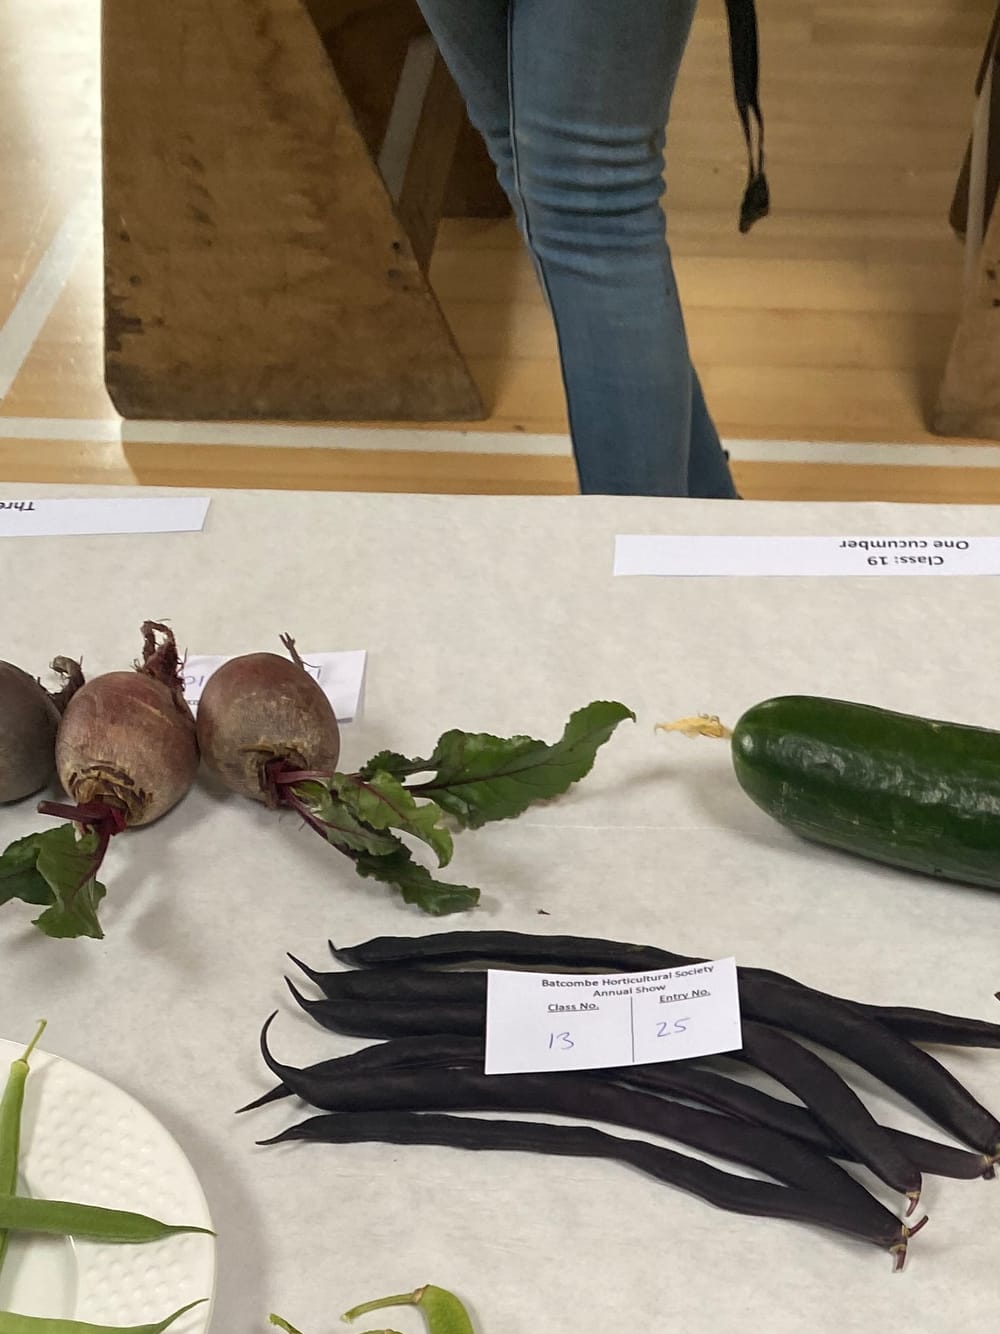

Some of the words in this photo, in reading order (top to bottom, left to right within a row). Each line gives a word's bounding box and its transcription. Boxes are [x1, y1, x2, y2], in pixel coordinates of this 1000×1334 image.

[0, 501, 35, 511] Thre
[839, 539, 927, 551] cucumber
[931, 539, 970, 551] One
[867, 555, 888, 566] 19
[894, 555, 945, 566] Class:
[542, 978, 599, 988] Batcombe
[602, 972, 672, 985] Horticultural
[675, 966, 714, 978] Society
[593, 988, 633, 997] Annual
[636, 984, 666, 994] Show
[659, 993, 689, 1003] Entry
[692, 988, 711, 997] No.
[548, 1003, 576, 1012] Class
[580, 1002, 599, 1010] No.
[656, 1017, 691, 1037] 25
[549, 1032, 574, 1050] 13
